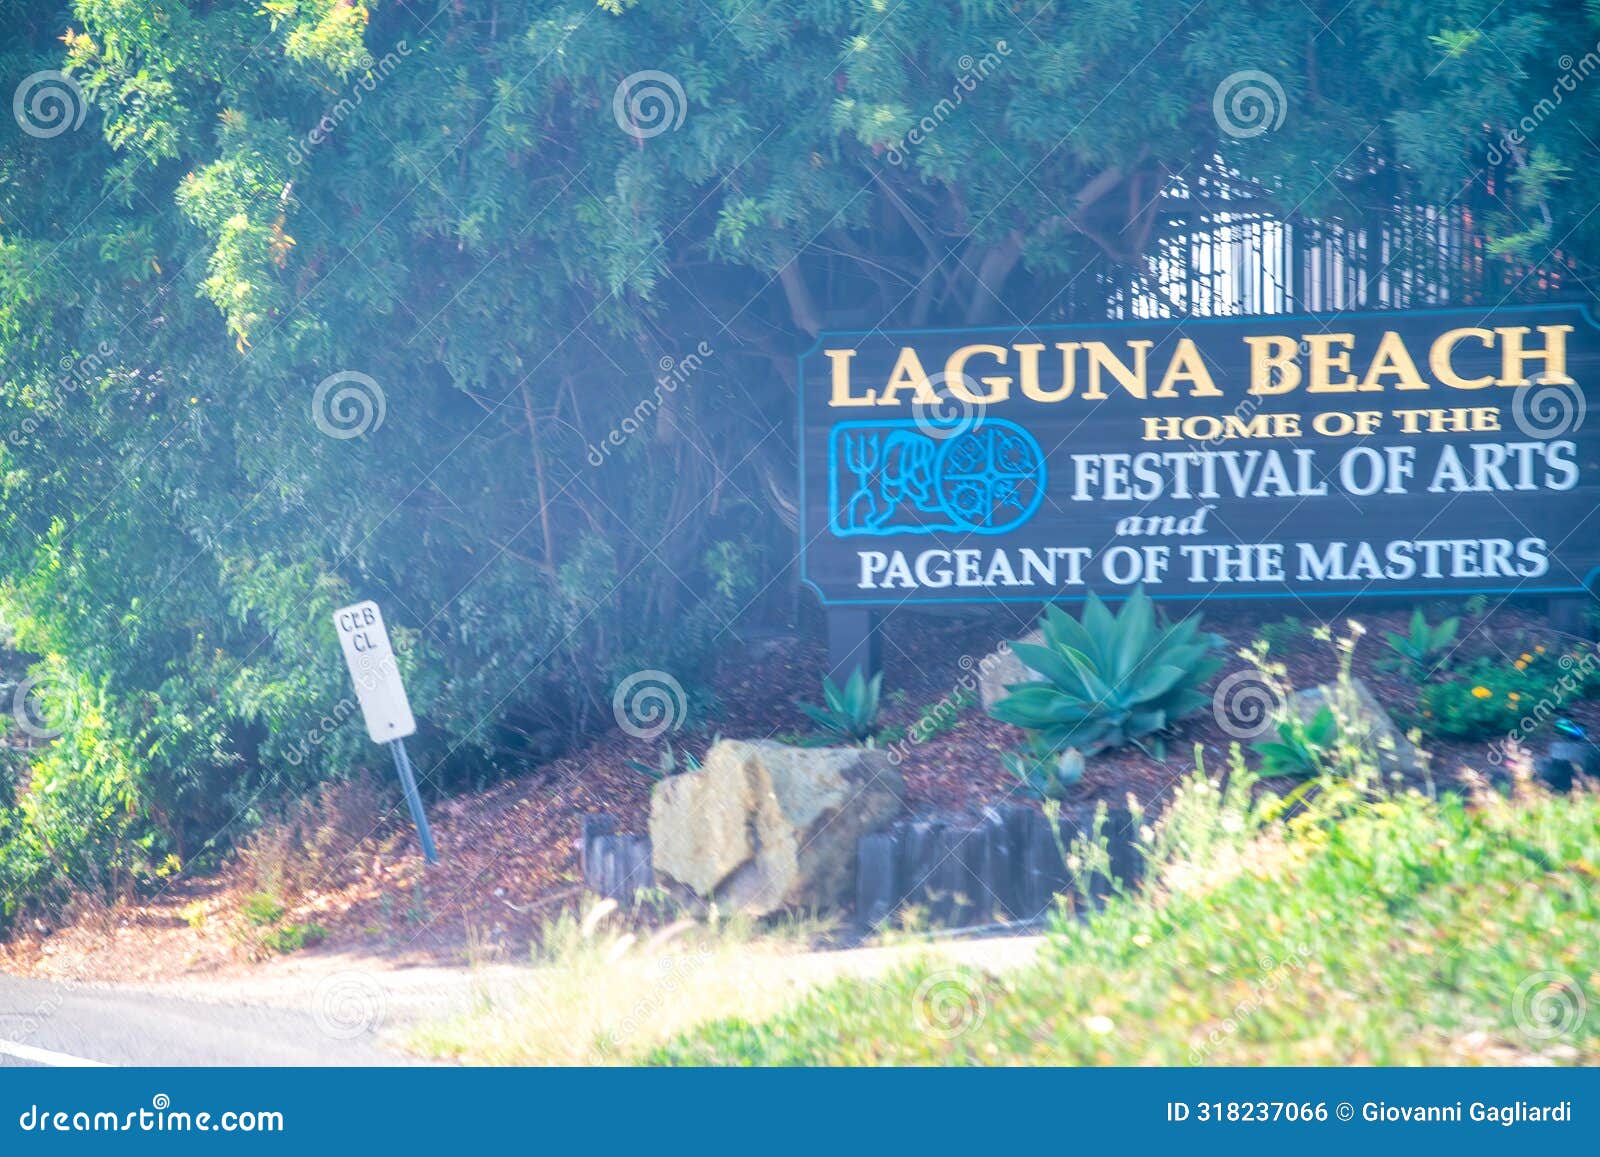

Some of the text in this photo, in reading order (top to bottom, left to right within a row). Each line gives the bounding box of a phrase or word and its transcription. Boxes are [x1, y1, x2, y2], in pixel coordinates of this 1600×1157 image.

[824, 325, 1575, 406] LAGUNA BEACH
[1140, 407, 1501, 441] HOME OF THE
[1070, 440, 1580, 501] FESTIVAL OF ARTS
[1115, 504, 1214, 537] and
[857, 537, 1550, 589] PAGEANT OF THE MASTERS
[353, 632, 377, 653] CL
